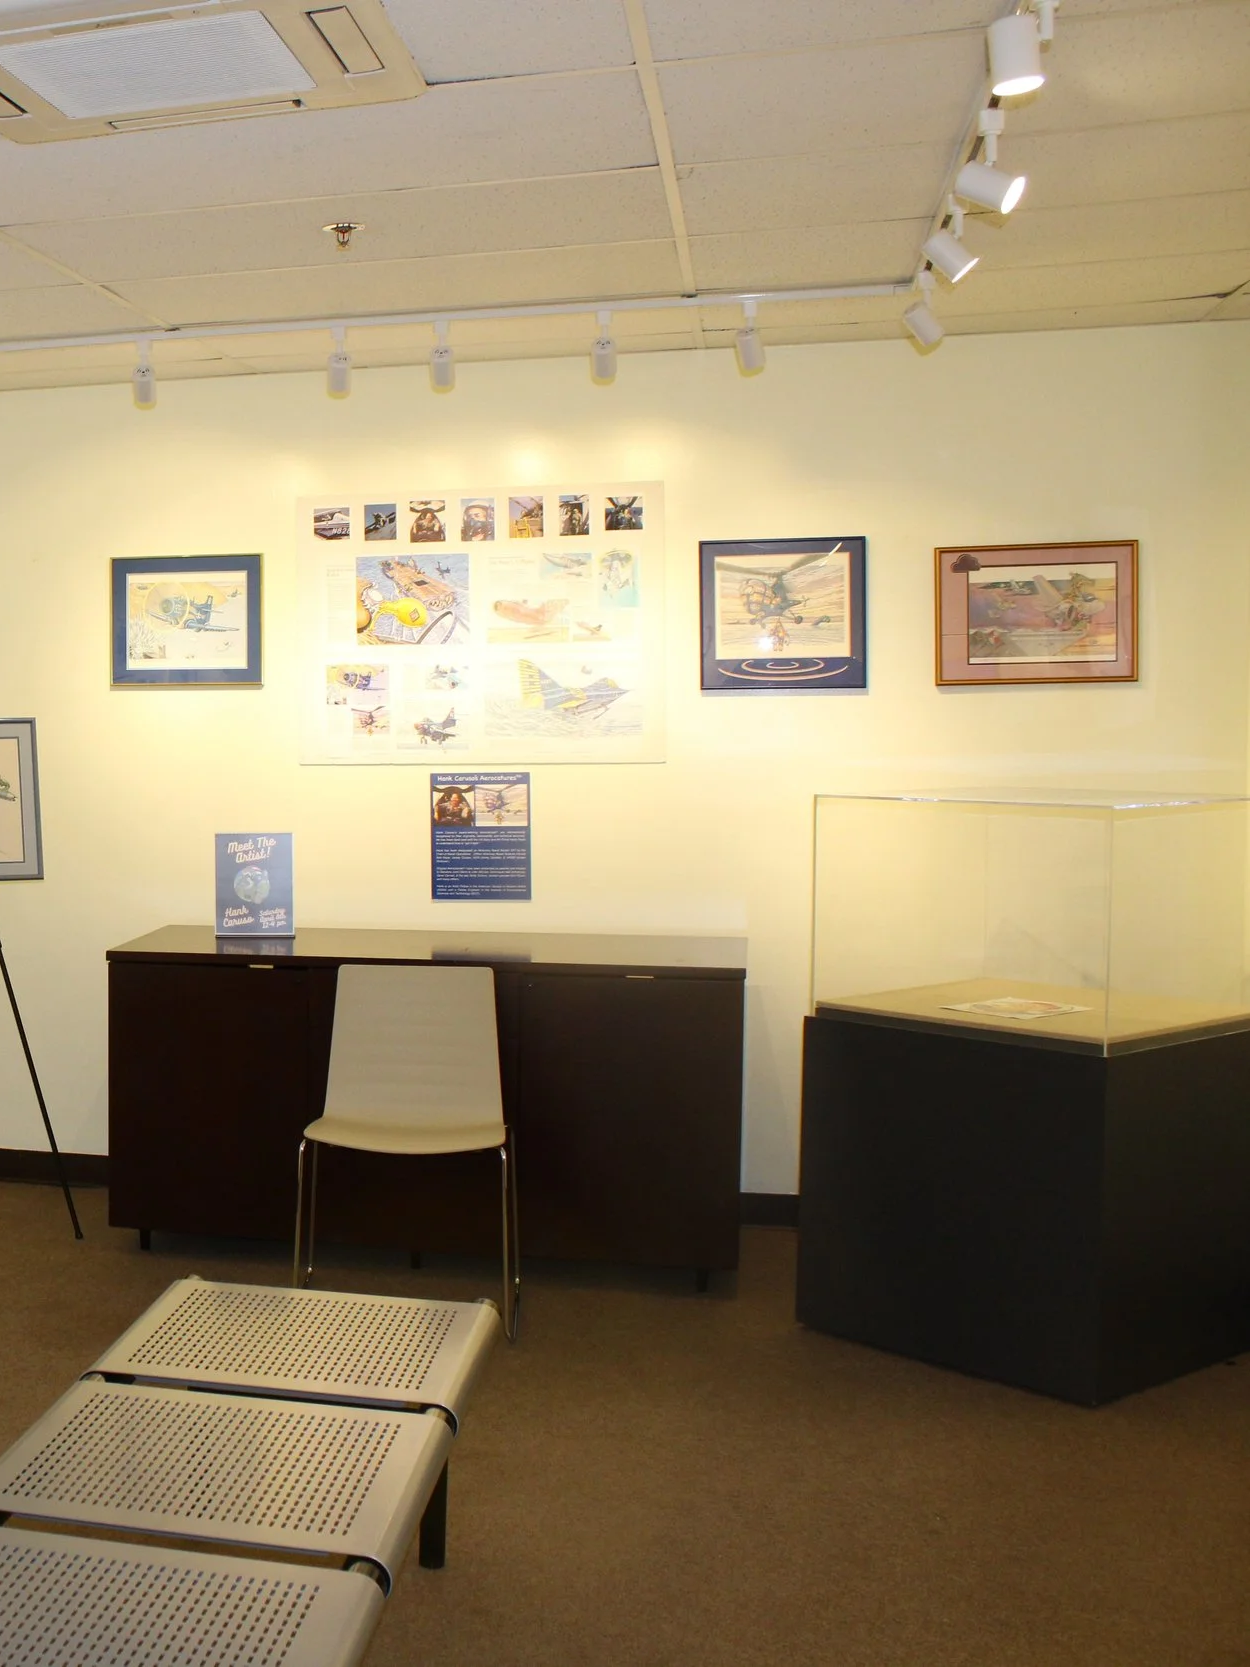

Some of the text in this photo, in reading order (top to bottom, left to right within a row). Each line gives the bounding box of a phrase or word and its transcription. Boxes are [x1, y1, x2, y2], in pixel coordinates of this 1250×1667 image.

[227, 836, 276, 854] Meet The
[236, 847, 270, 863] Artist!
[225, 905, 249, 917] Hank
[223, 916, 254, 927] Caruso
